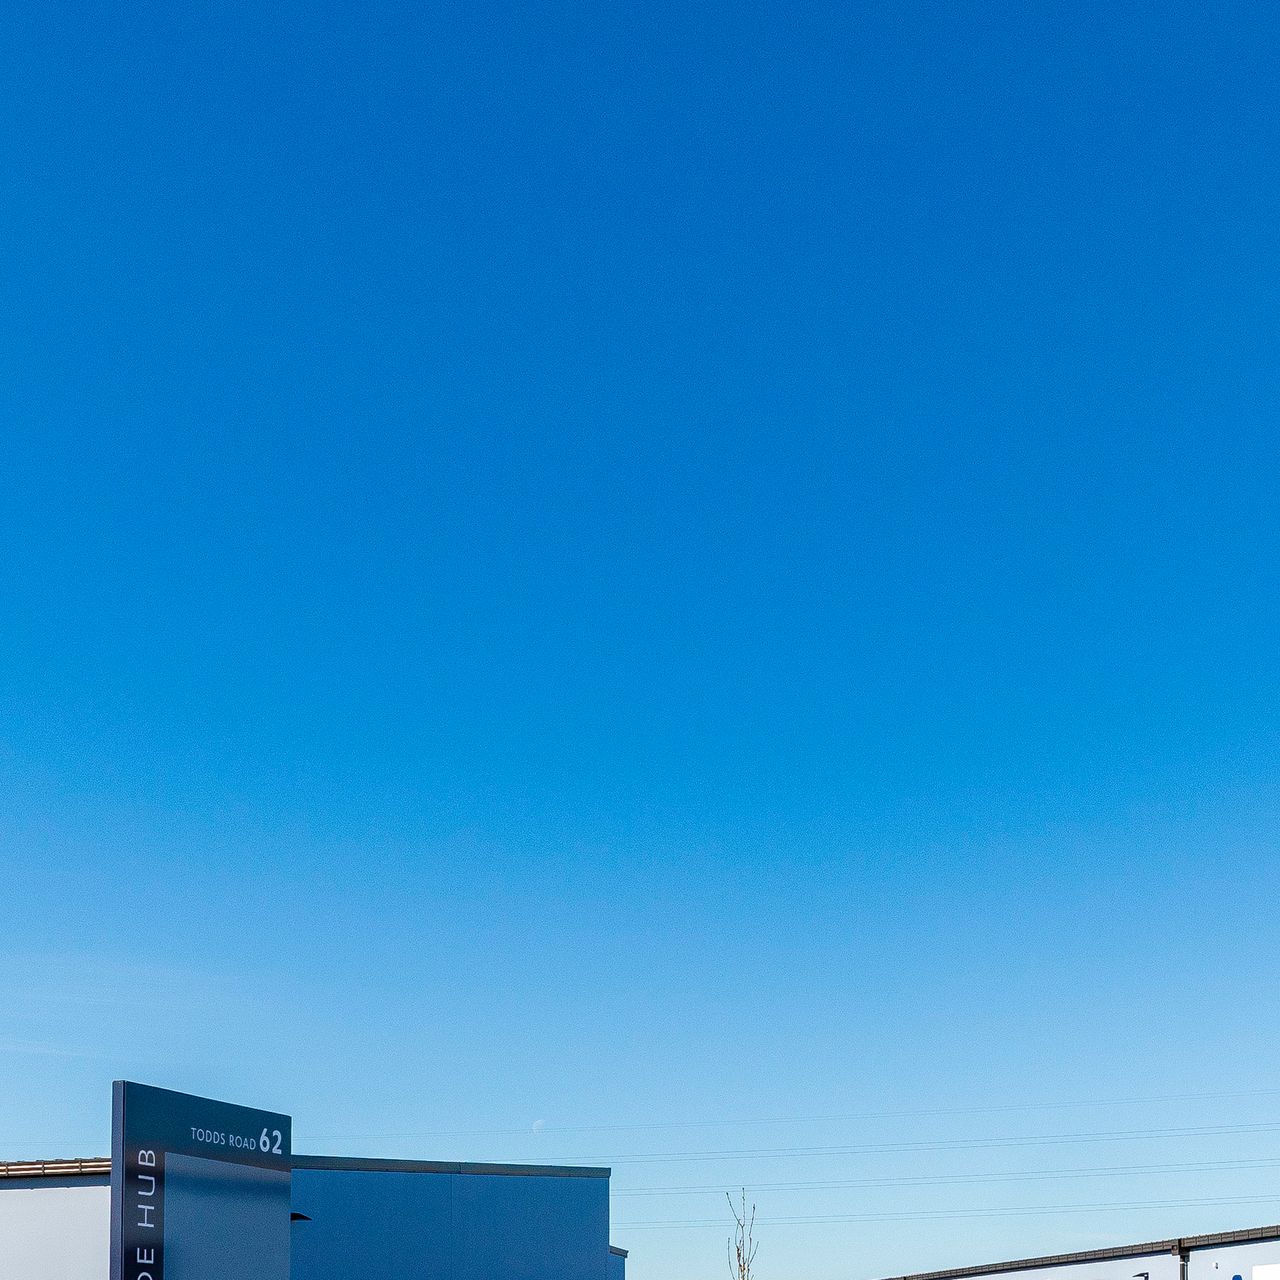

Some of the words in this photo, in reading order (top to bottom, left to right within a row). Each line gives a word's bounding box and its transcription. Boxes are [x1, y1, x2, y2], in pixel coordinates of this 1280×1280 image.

[190, 1127, 226, 1146] TODDS
[229, 1134, 257, 1151] ROAD
[259, 1128, 283, 1155] 62
[138, 1149, 156, 1228] HUB
